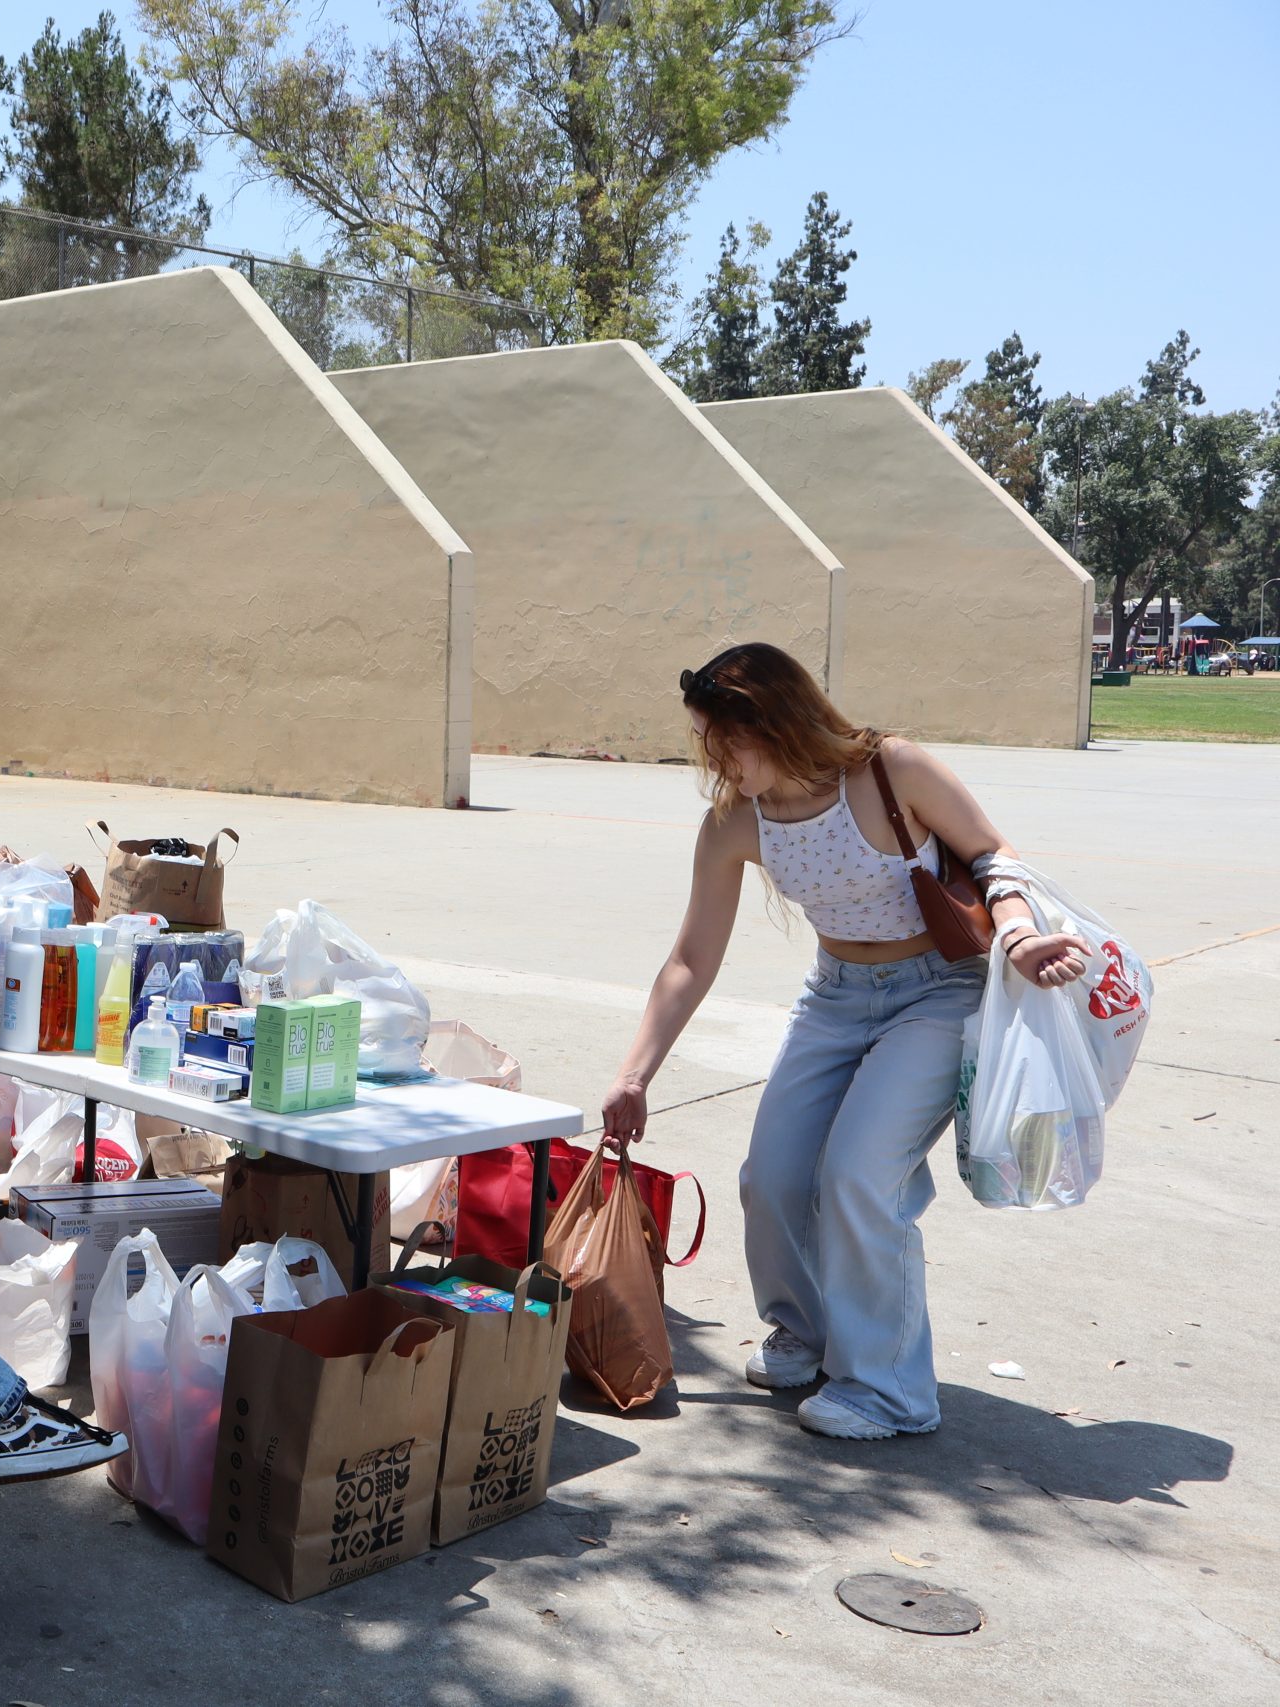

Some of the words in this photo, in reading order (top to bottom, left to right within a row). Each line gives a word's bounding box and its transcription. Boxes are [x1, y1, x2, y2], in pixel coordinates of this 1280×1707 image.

[289, 1024, 308, 1042] Bio
[317, 1021, 336, 1040] Bio
[288, 1040, 307, 1056] true
[316, 1039, 335, 1053] true
[72, 1226, 91, 1235] 560
[328, 1564, 368, 1586] Bristol
[367, 1553, 401, 1572] Farms
